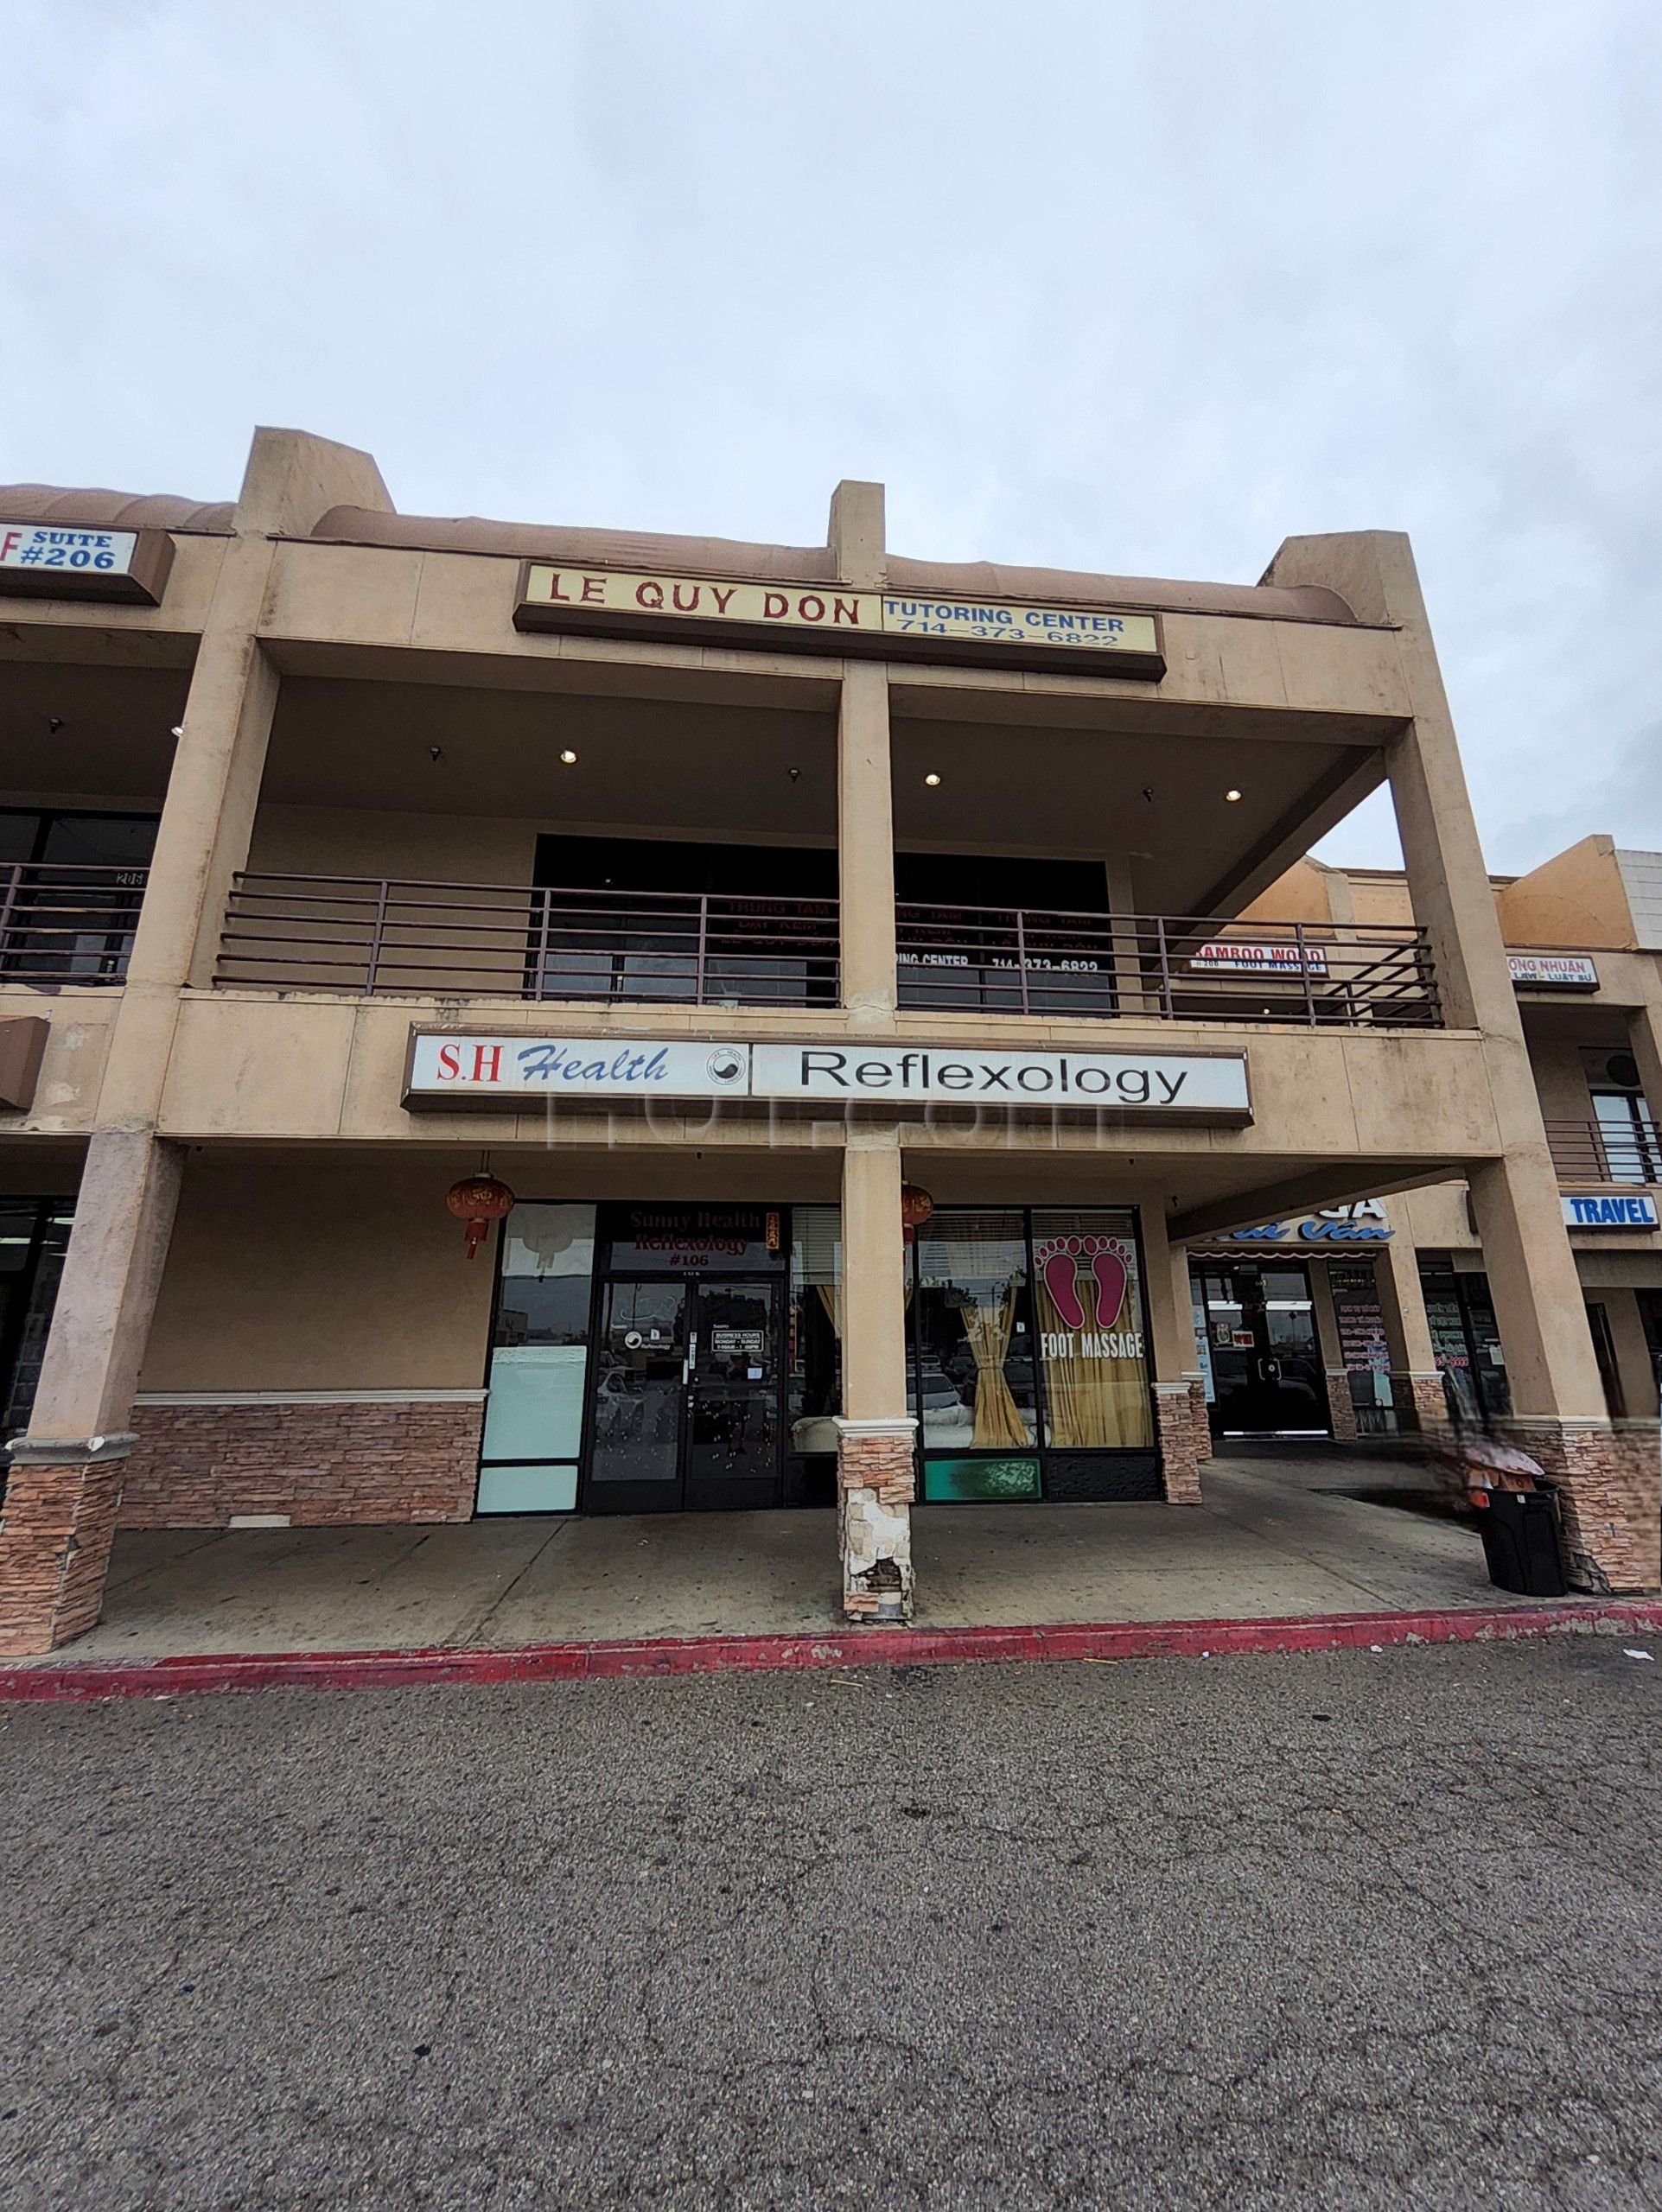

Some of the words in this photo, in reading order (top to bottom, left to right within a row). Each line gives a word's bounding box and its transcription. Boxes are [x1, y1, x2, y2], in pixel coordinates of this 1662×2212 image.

[32, 531, 113, 548] SUITE
[20, 545, 116, 569] #206
[551, 572, 608, 604] LE
[635, 581, 738, 616] QUY
[762, 592, 861, 626] DON
[883, 600, 1014, 627] TUTORING
[1025, 611, 1125, 633] CENTER
[896, 618, 1120, 648] 714-373-6822
[1269, 962, 1322, 972] MASSGE
[436, 1044, 502, 1084] S.H
[517, 1044, 669, 1082] Health
[800, 1051, 1188, 1105] Reflexology
[630, 1211, 691, 1232] Sunny
[697, 1211, 761, 1229] Health
[1570, 1198, 1655, 1224] TRAVEL
[634, 1233, 748, 1255] Reflexology
[669, 1254, 710, 1267] #106
[1040, 1332, 1074, 1358] FOOT
[1080, 1332, 1144, 1358] MASSAGE
